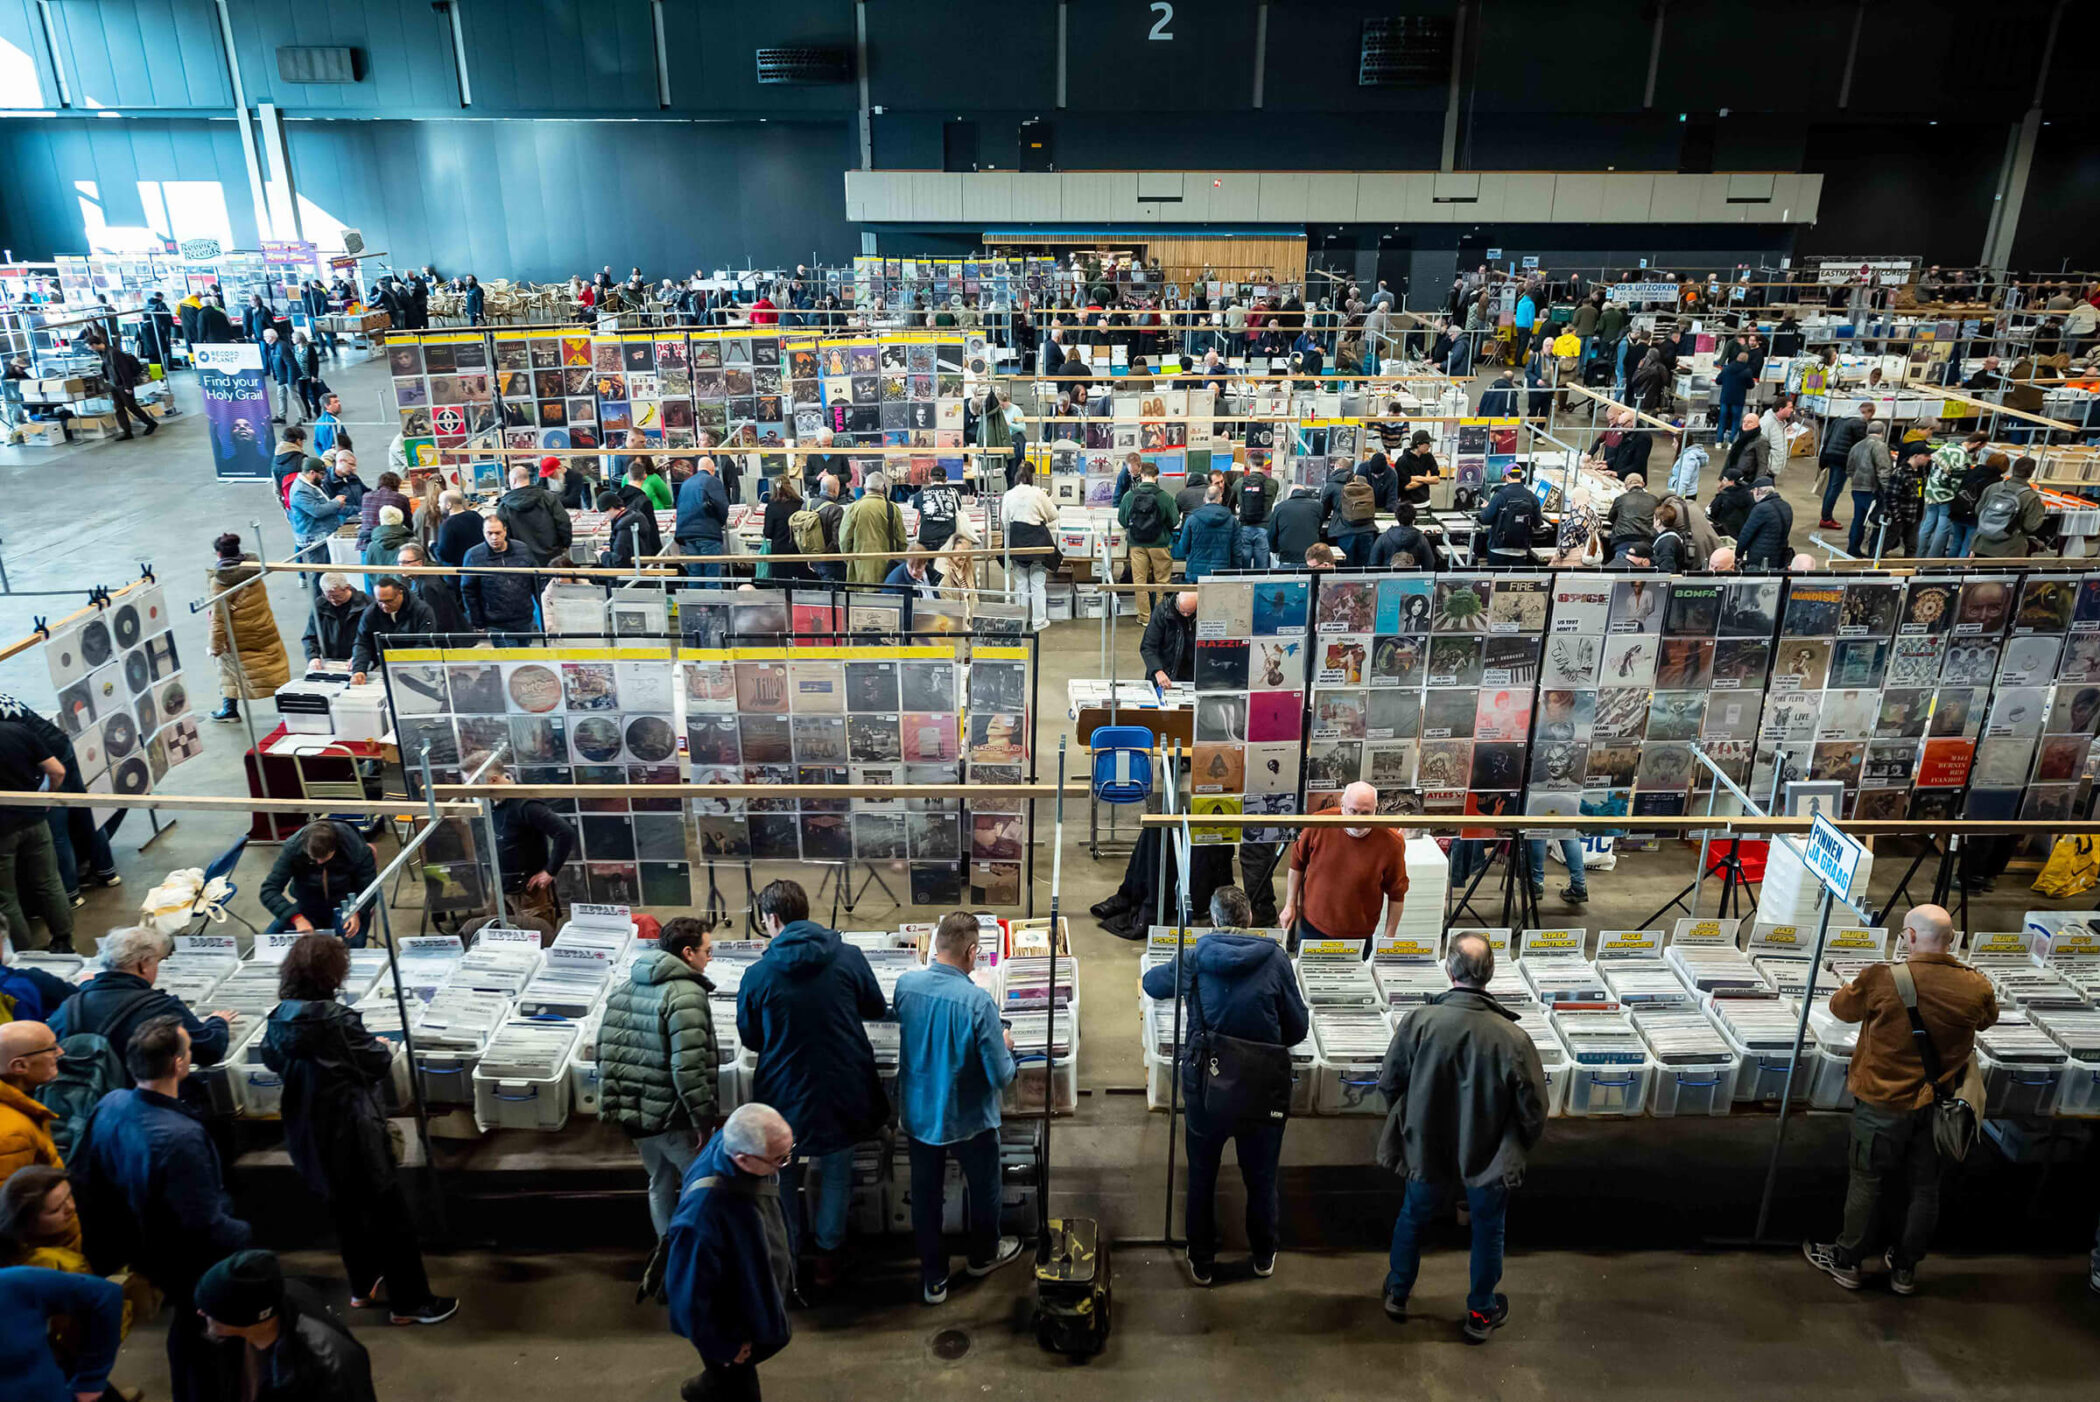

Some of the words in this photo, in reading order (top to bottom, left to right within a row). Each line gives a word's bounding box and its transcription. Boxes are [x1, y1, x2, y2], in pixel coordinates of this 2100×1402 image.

[1148, 2, 1173, 40] 2
[1820, 270, 1858, 278] EASTMAN
[1635, 284, 1678, 292] UITZOEKEN
[203, 375, 231, 387] Find
[232, 378, 259, 389] your
[206, 389, 235, 403] Holy
[236, 389, 264, 401] Grail
[1509, 582, 1535, 592] FIRE
[1674, 589, 1718, 598] BONFA
[1196, 639, 1250, 648] RAZZIA
[1794, 713, 1810, 721] LIVE
[972, 745, 1022, 753] RADIOHEAD
[1813, 824, 1843, 862] PINNEN
[1808, 844, 1820, 864] JA
[1820, 853, 1849, 892] GRAAG
[578, 904, 618, 915] METAL
[1697, 921, 1720, 929] JAZZ
[487, 930, 528, 941] METAL
[1773, 927, 1797, 935] JAZZ
[189, 937, 225, 947] ROCK
[552, 949, 594, 959] METAL
